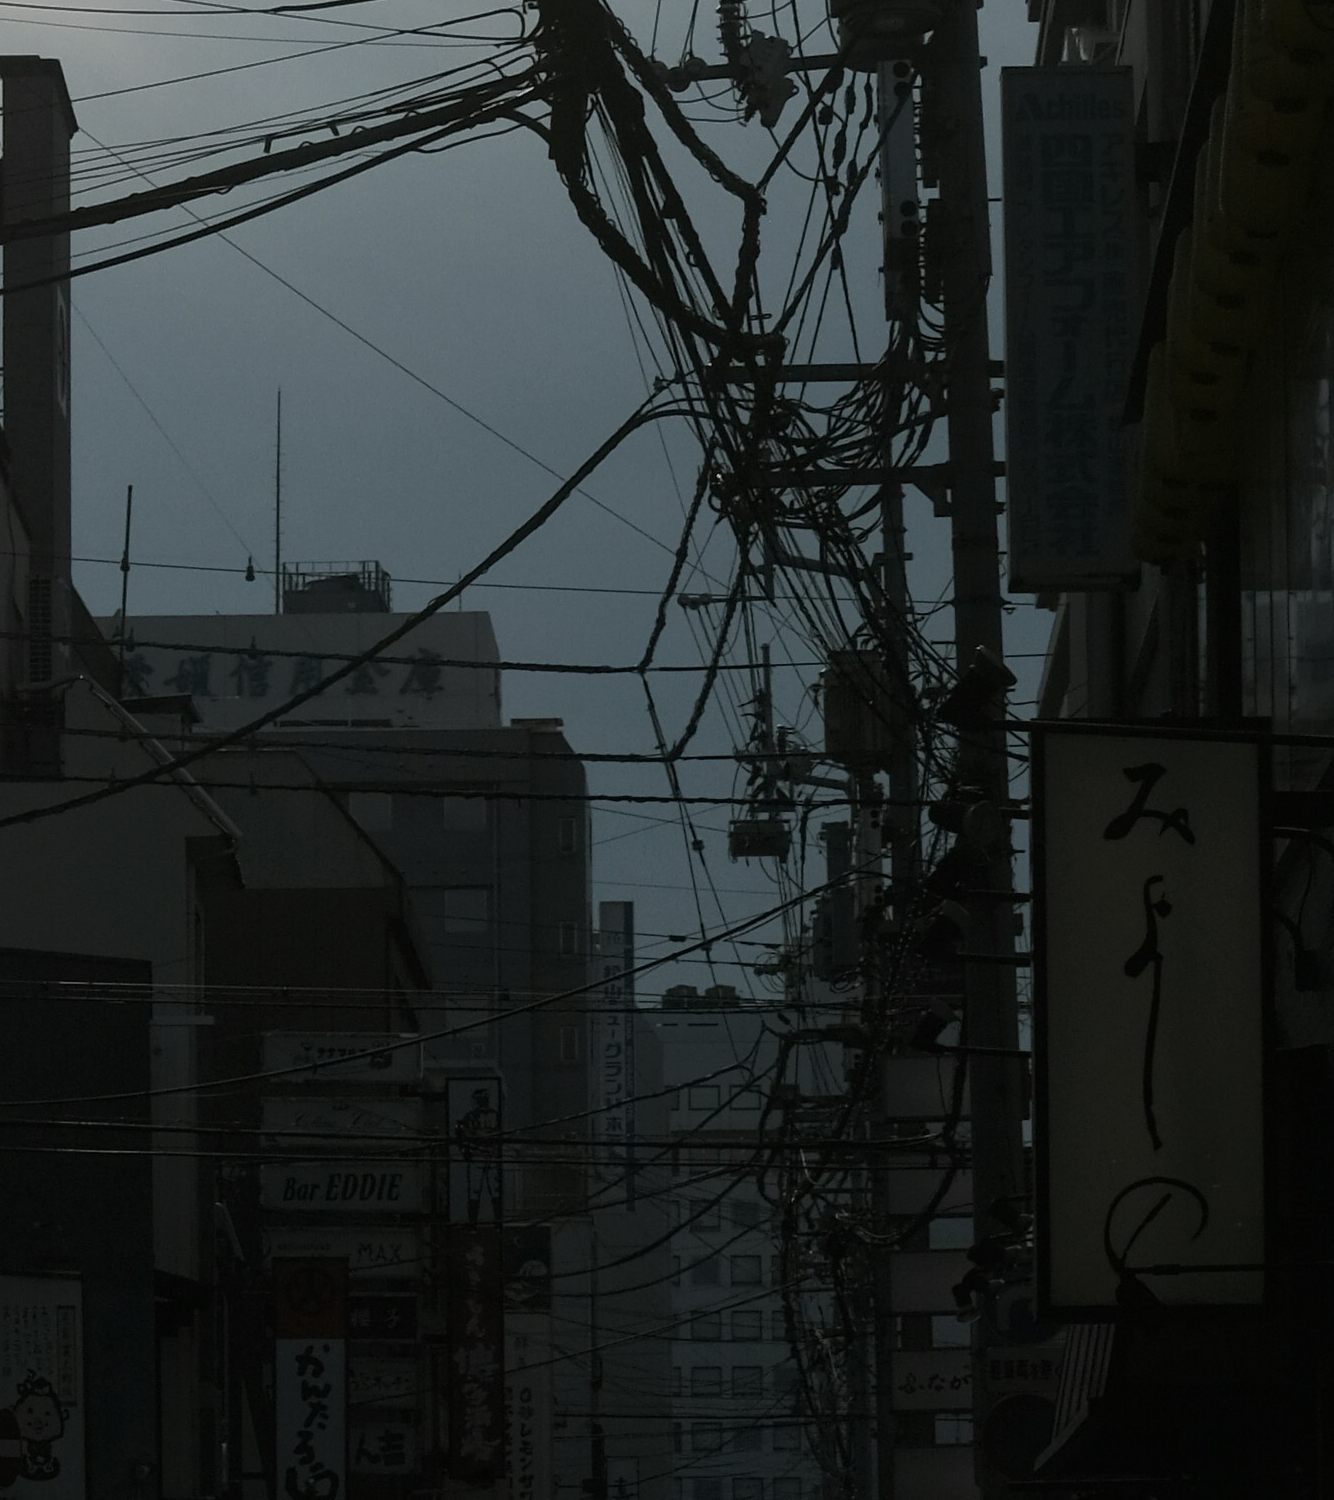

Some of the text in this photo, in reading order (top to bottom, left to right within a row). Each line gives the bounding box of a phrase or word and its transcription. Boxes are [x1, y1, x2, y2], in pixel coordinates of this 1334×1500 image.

[1015, 92, 1126, 122] Achilles
[1041, 133, 1099, 557] 四国エアフォーム株式会社
[283, 1173, 403, 1201] Bar EDDIE
[356, 1241, 402, 1263] MAX
